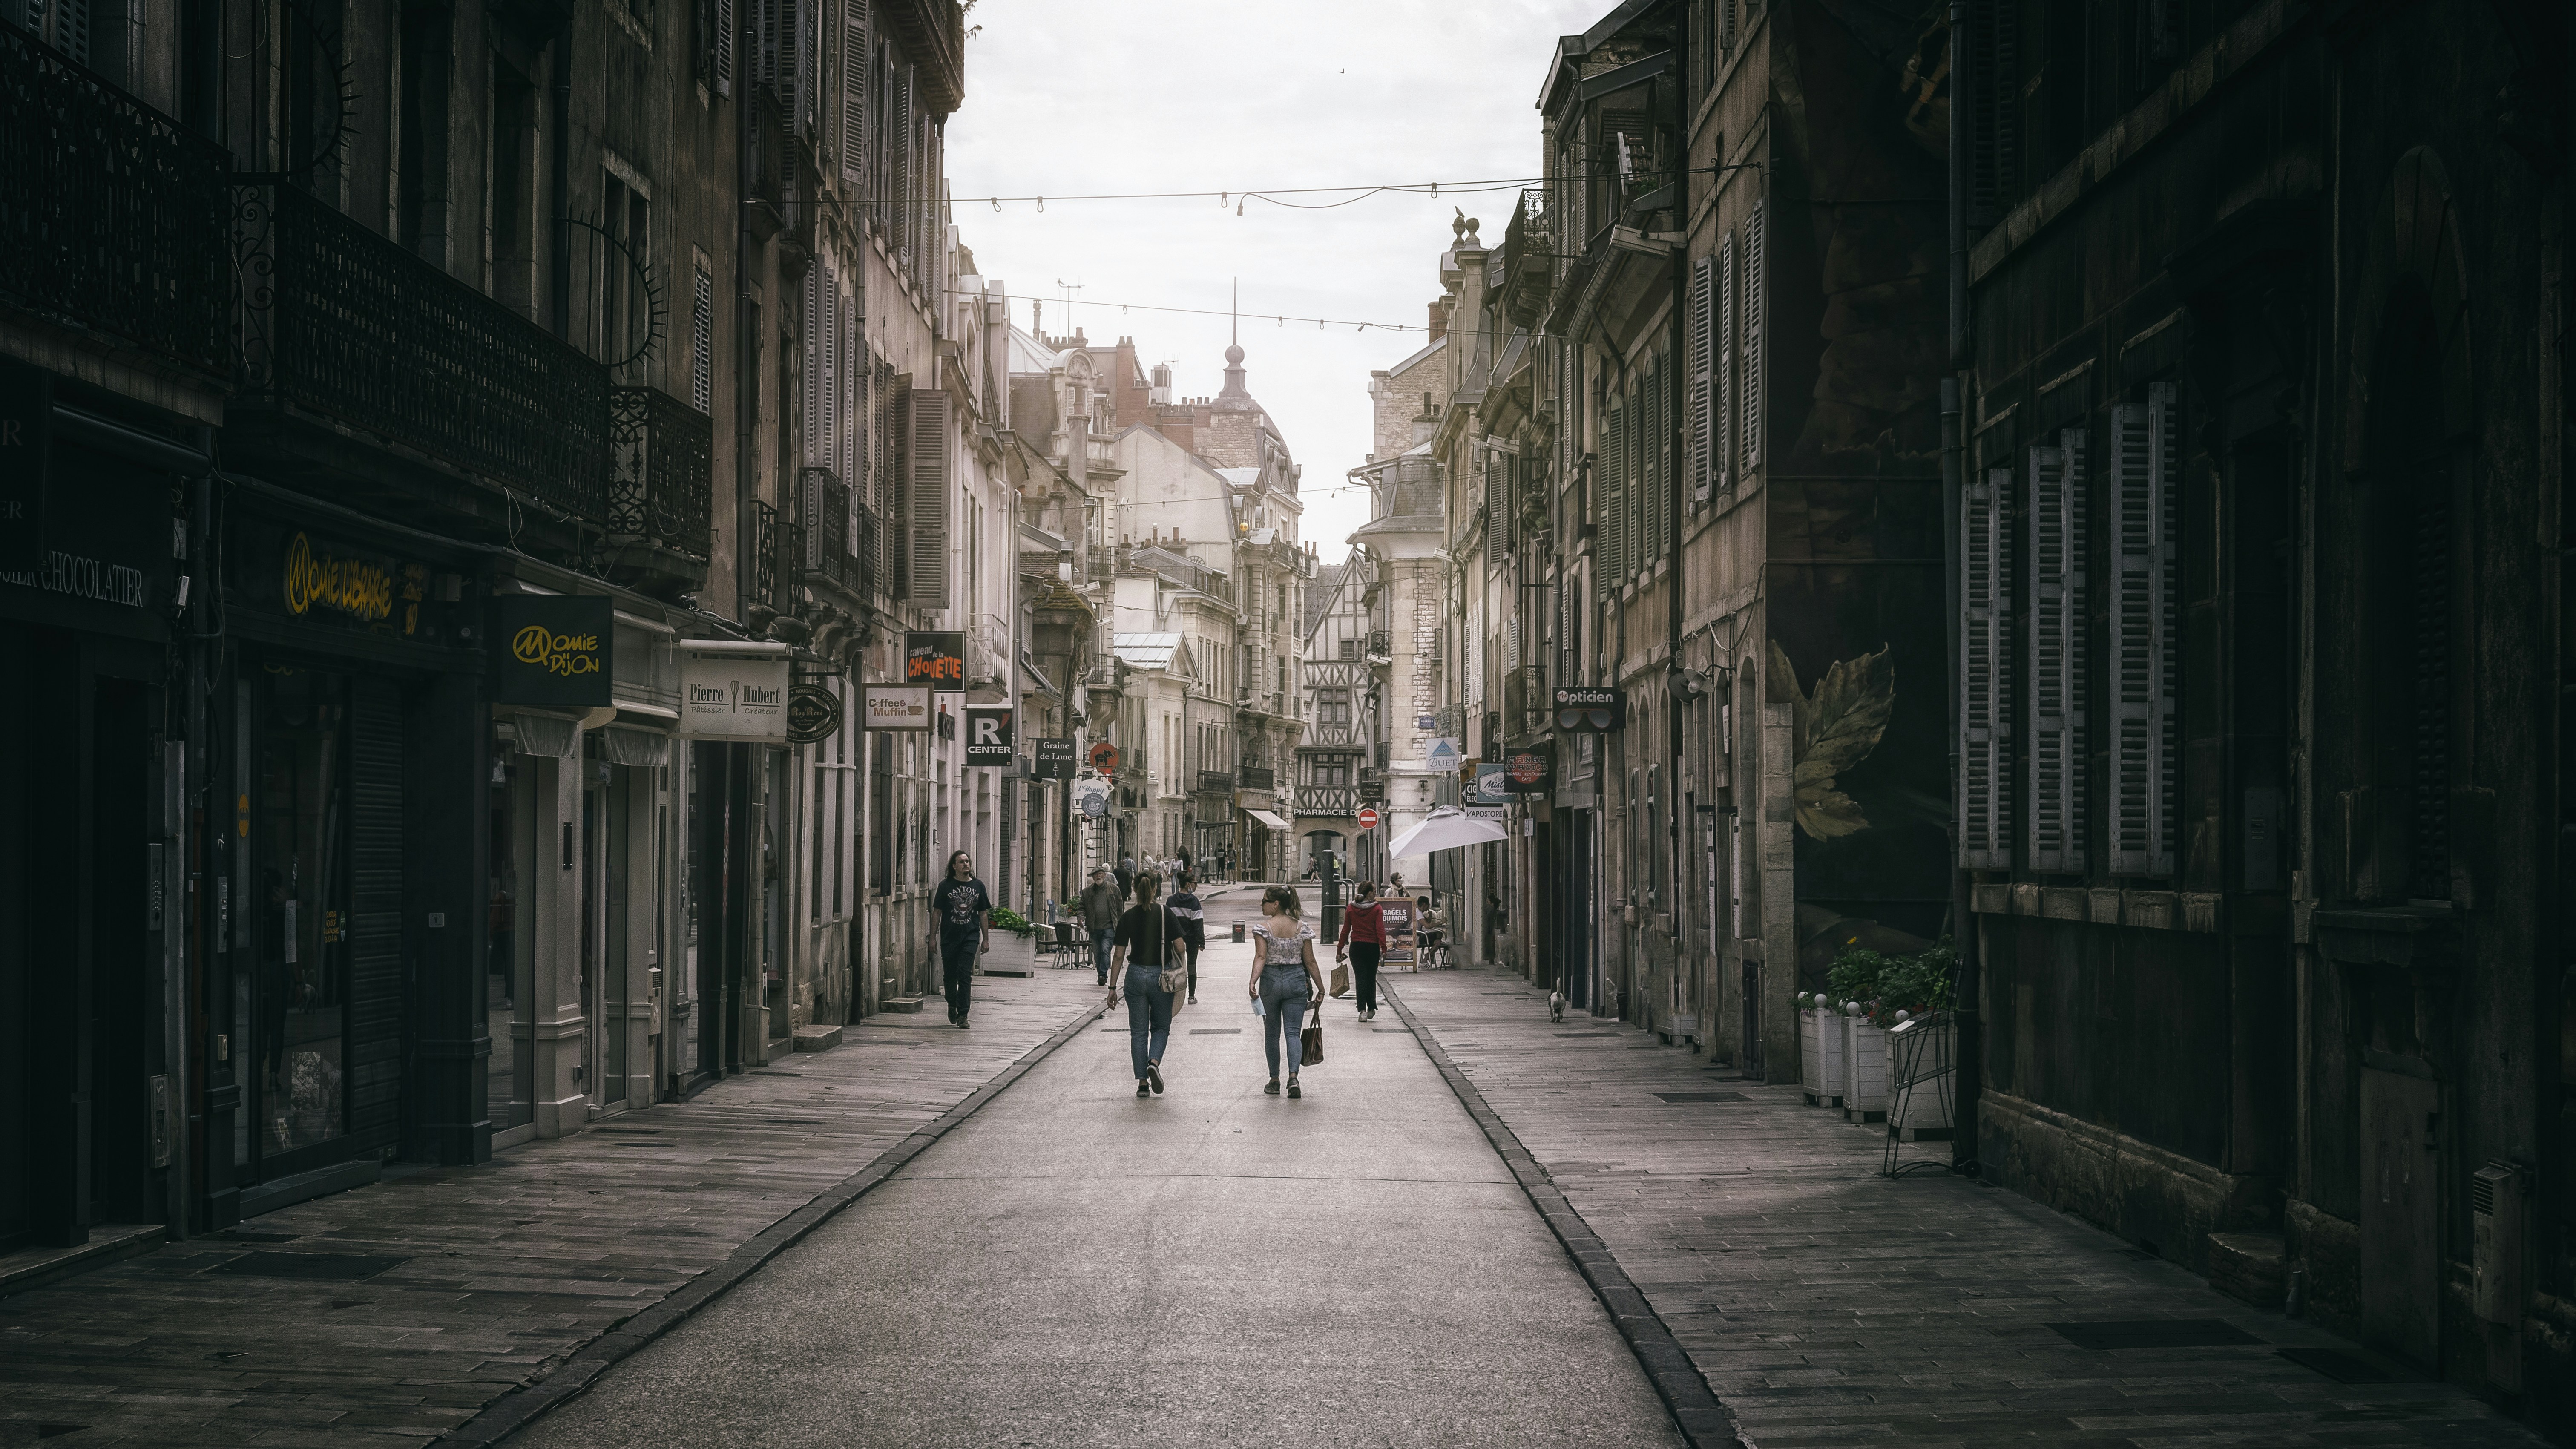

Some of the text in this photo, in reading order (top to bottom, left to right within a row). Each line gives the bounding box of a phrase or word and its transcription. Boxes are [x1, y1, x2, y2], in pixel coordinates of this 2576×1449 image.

[406, 603, 418, 635] BD
[910, 645, 933, 657] caveau
[908, 656, 962, 679] CHOUETTE
[690, 684, 780, 704] Pierre Hubert
[1557, 692, 1567, 700] The
[822, 694, 837, 710] BISCUITS
[790, 706, 805, 718] Roy
[805, 706, 823, 716] René
[874, 707, 906, 716] Muffin
[812, 721, 835, 737] CONFITURES
[154, 733, 164, 756] 27
[1429, 757, 1458, 767] BUET
[1507, 755, 1546, 763] MANGA
[1078, 785, 1104, 795] l'Happy
[1467, 785, 1477, 793] CIG
[1484, 780, 1504, 788] Mist
[947, 885, 979, 900] DAYTONA
[950, 915, 971, 924] RACEWAY
